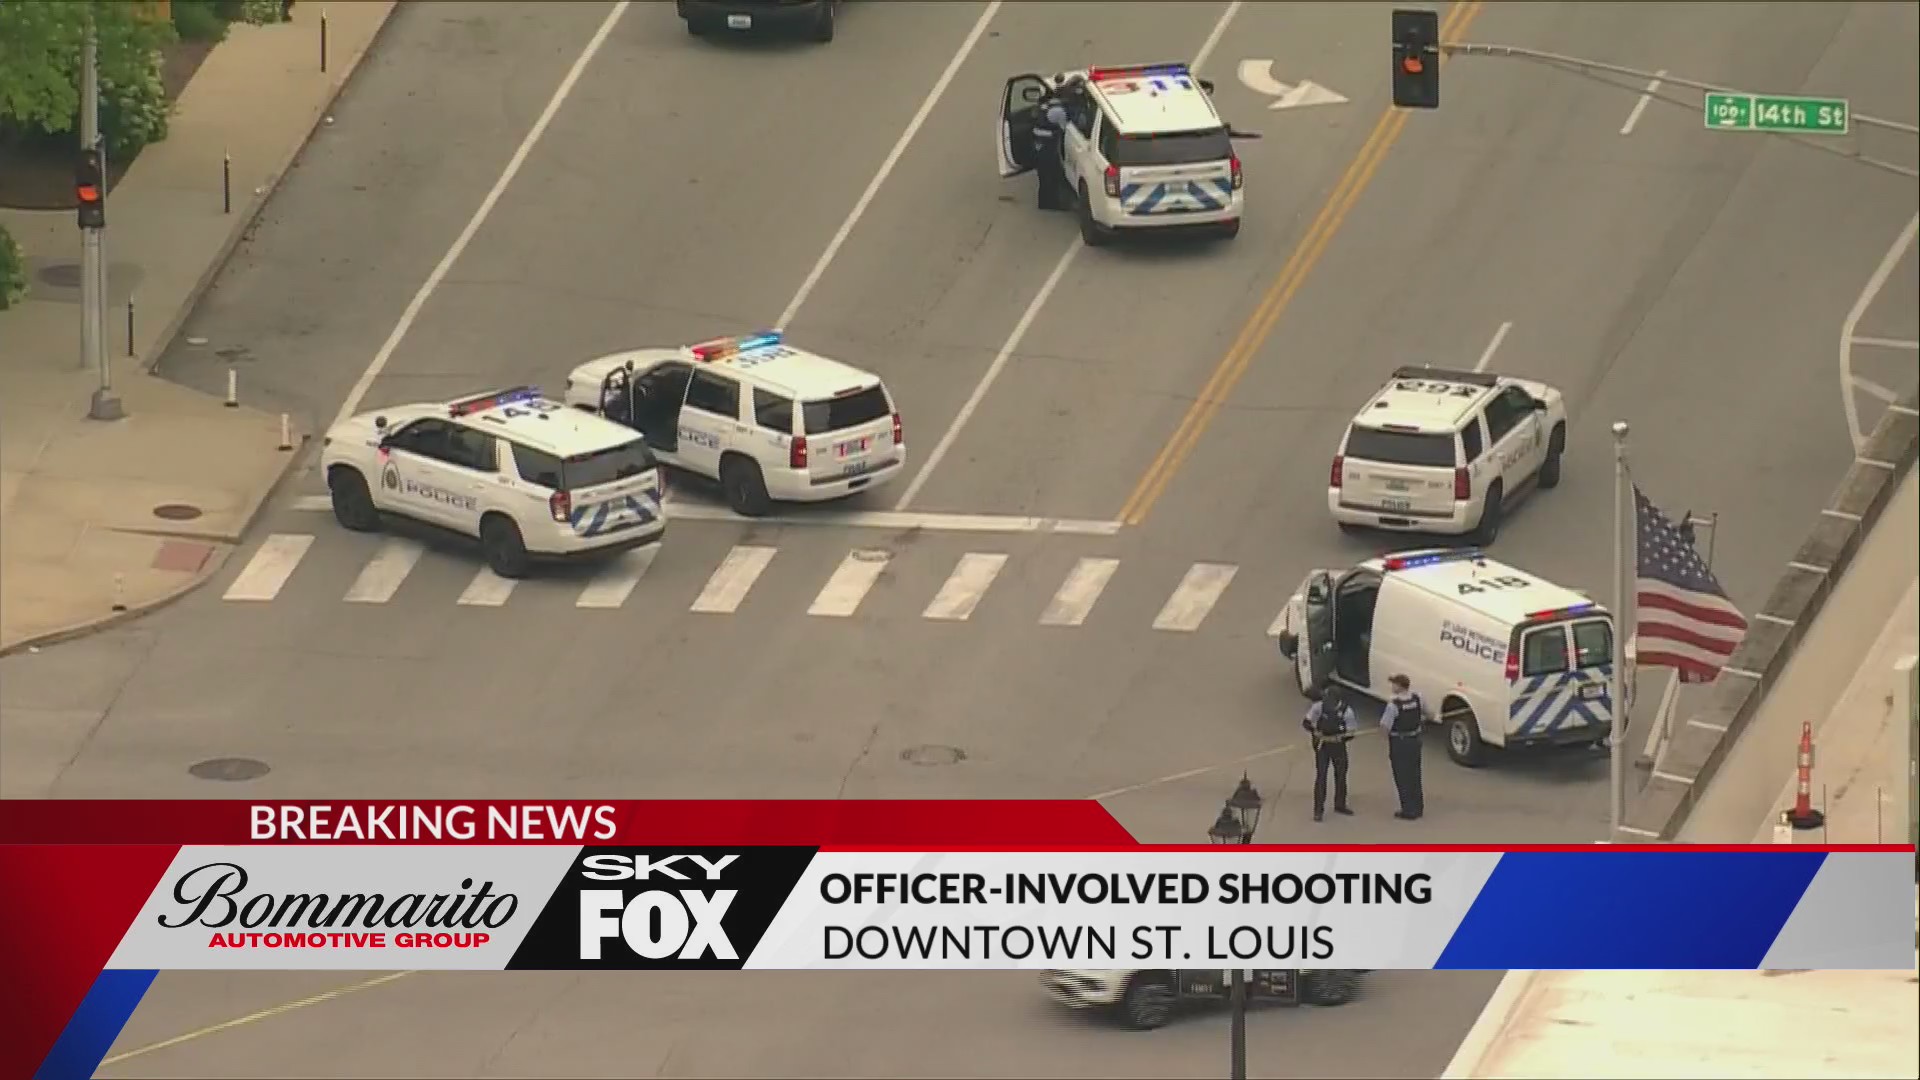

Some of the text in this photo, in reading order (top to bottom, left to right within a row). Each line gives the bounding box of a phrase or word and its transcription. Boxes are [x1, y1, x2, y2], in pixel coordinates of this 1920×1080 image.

[1757, 104, 1844, 126] 14th St
[406, 479, 478, 511] POLICE
[1458, 575, 1531, 595] 418
[1440, 629, 1505, 664] POLICE
